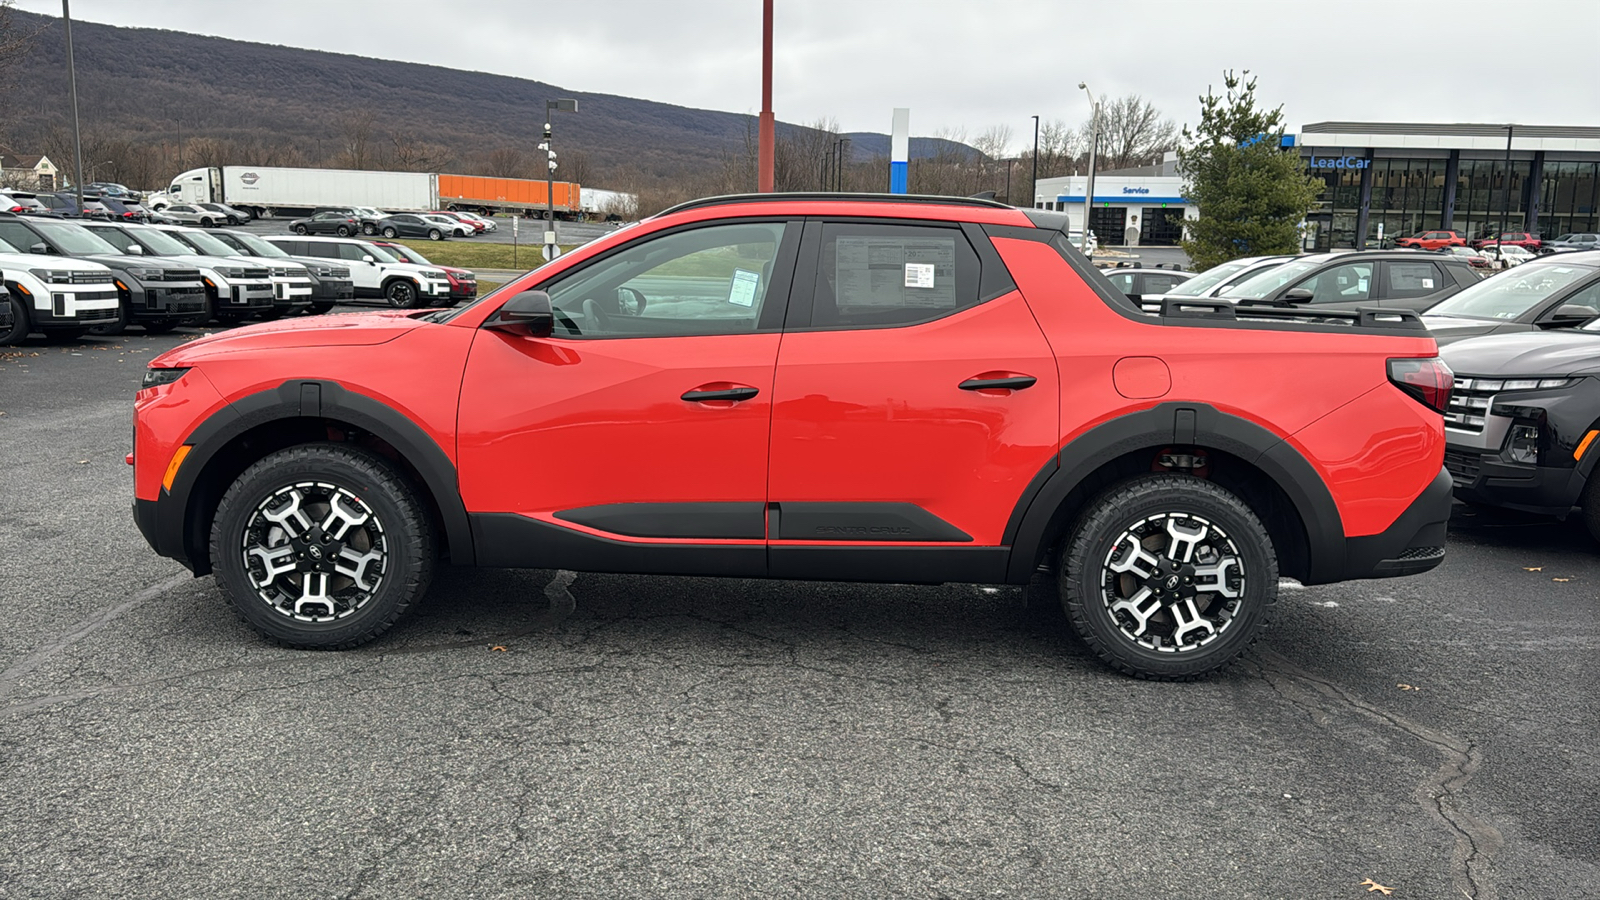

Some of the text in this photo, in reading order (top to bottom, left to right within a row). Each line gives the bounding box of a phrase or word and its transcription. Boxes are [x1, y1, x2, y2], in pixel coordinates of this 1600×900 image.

[1310, 156, 1371, 169] LeadCar
[1123, 186, 1150, 194] Service
[815, 525, 911, 535] SANTA CRUZ
